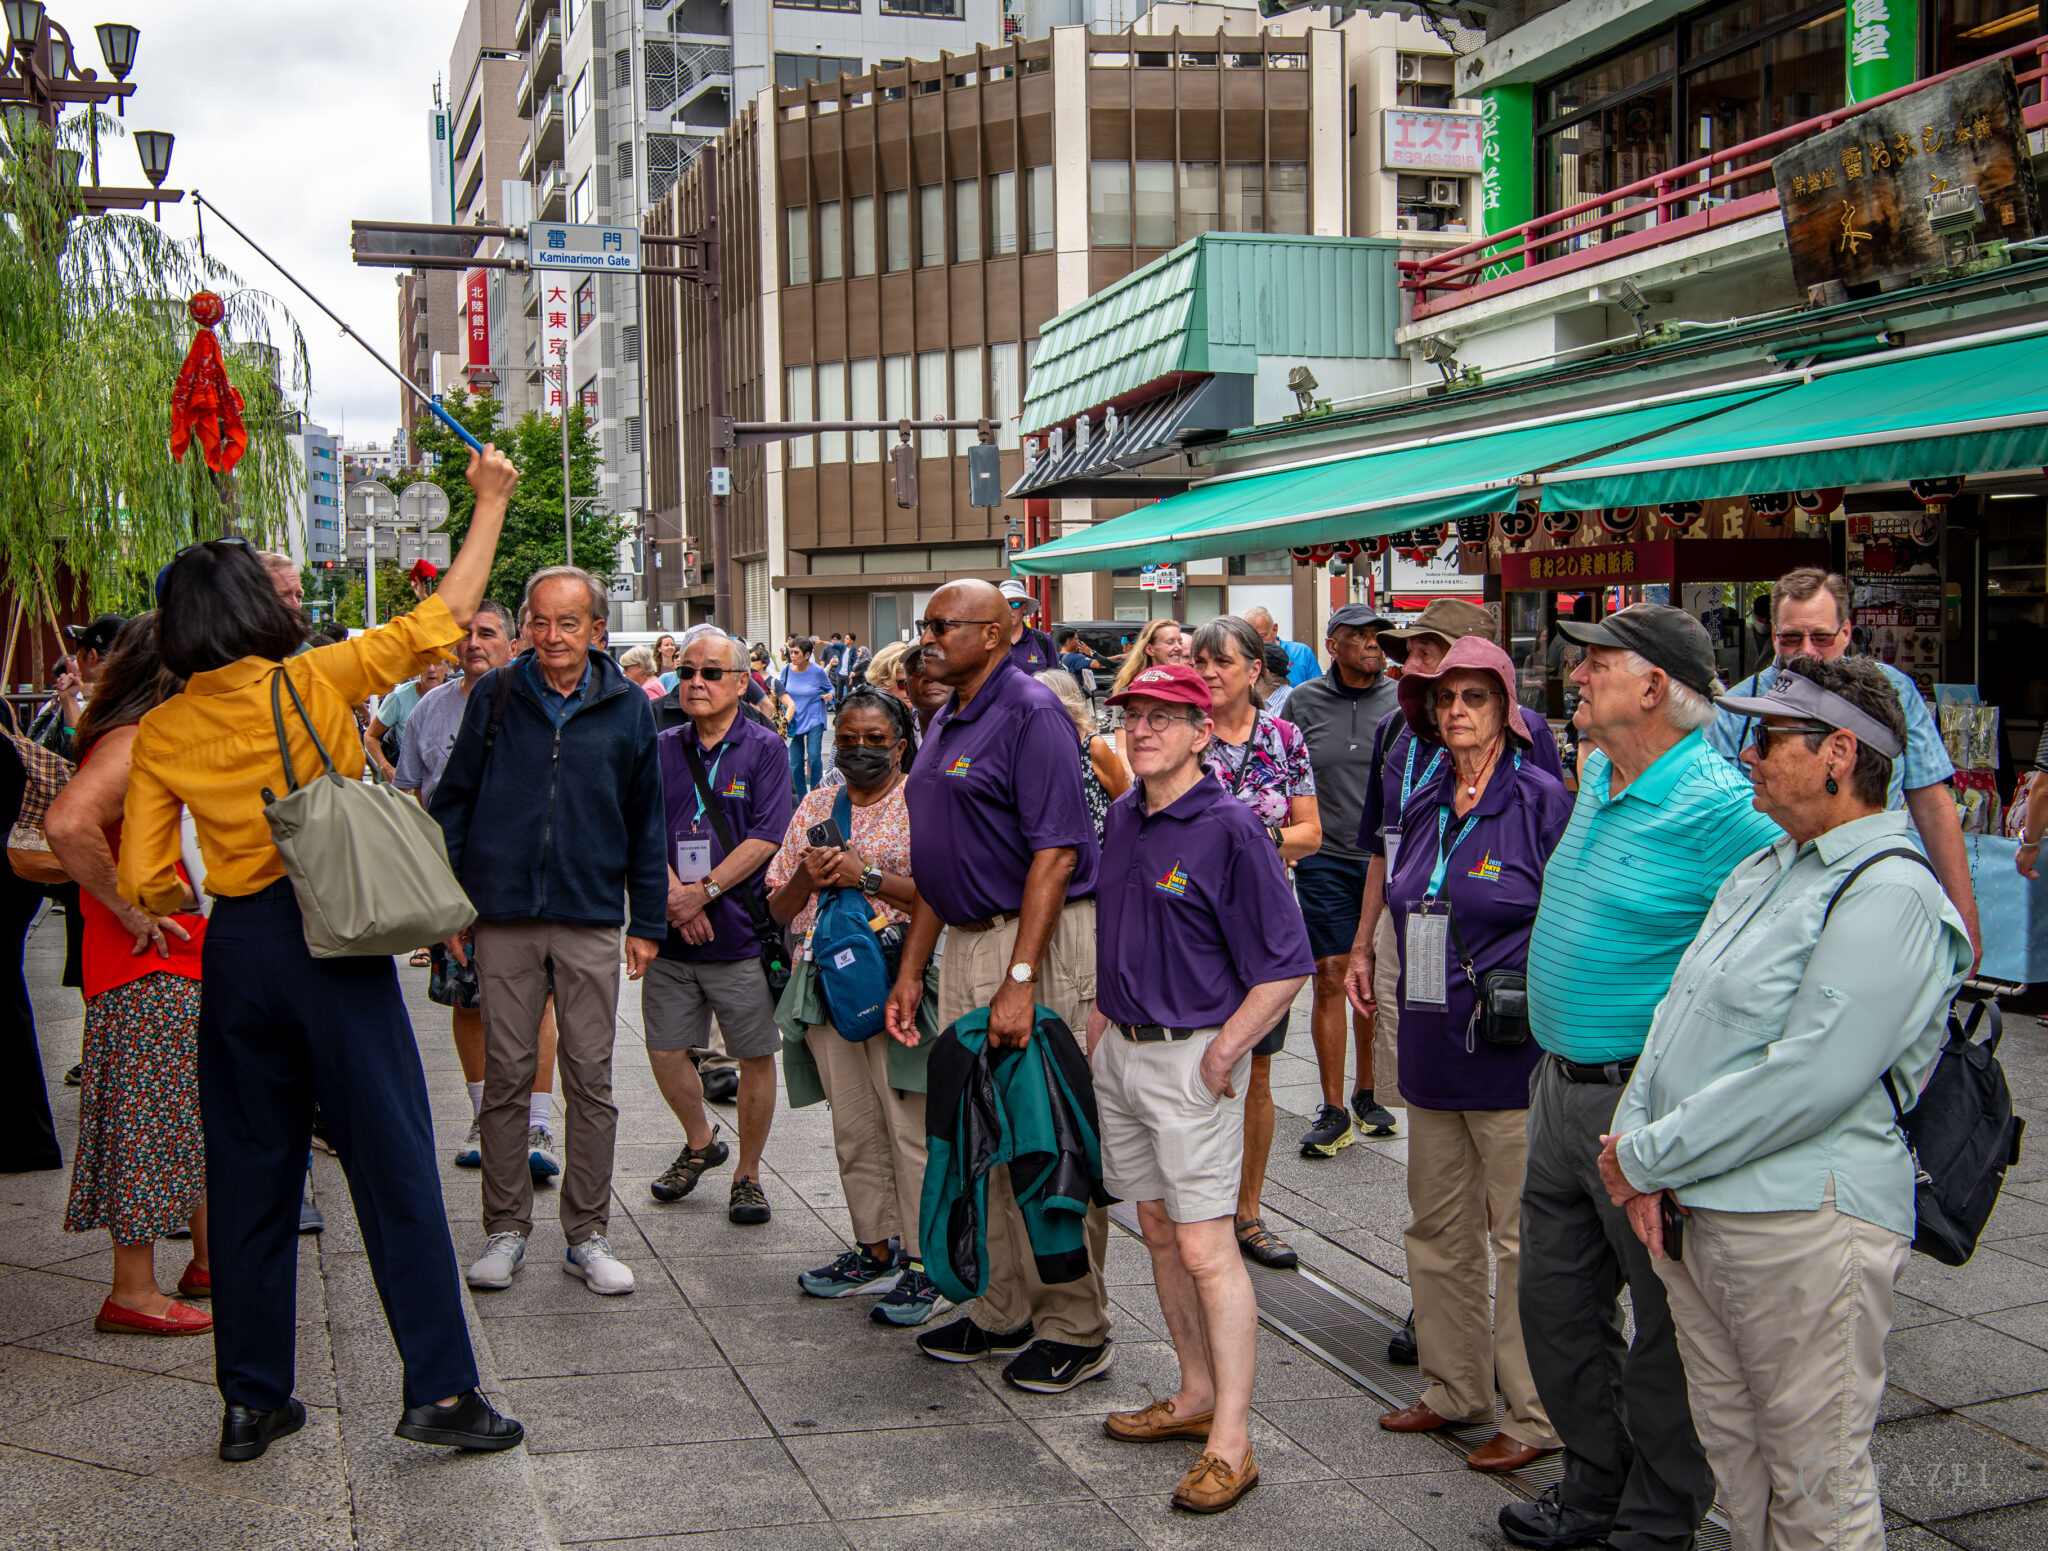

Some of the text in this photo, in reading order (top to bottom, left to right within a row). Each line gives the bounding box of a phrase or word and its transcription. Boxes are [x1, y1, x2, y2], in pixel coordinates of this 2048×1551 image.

[547, 229, 622, 252] 雷門
[539, 251, 631, 267] Kaminarimon Gate
[471, 286, 485, 341] 北陸銀行
[1529, 549, 1635, 579] 雷おこし実演販売
